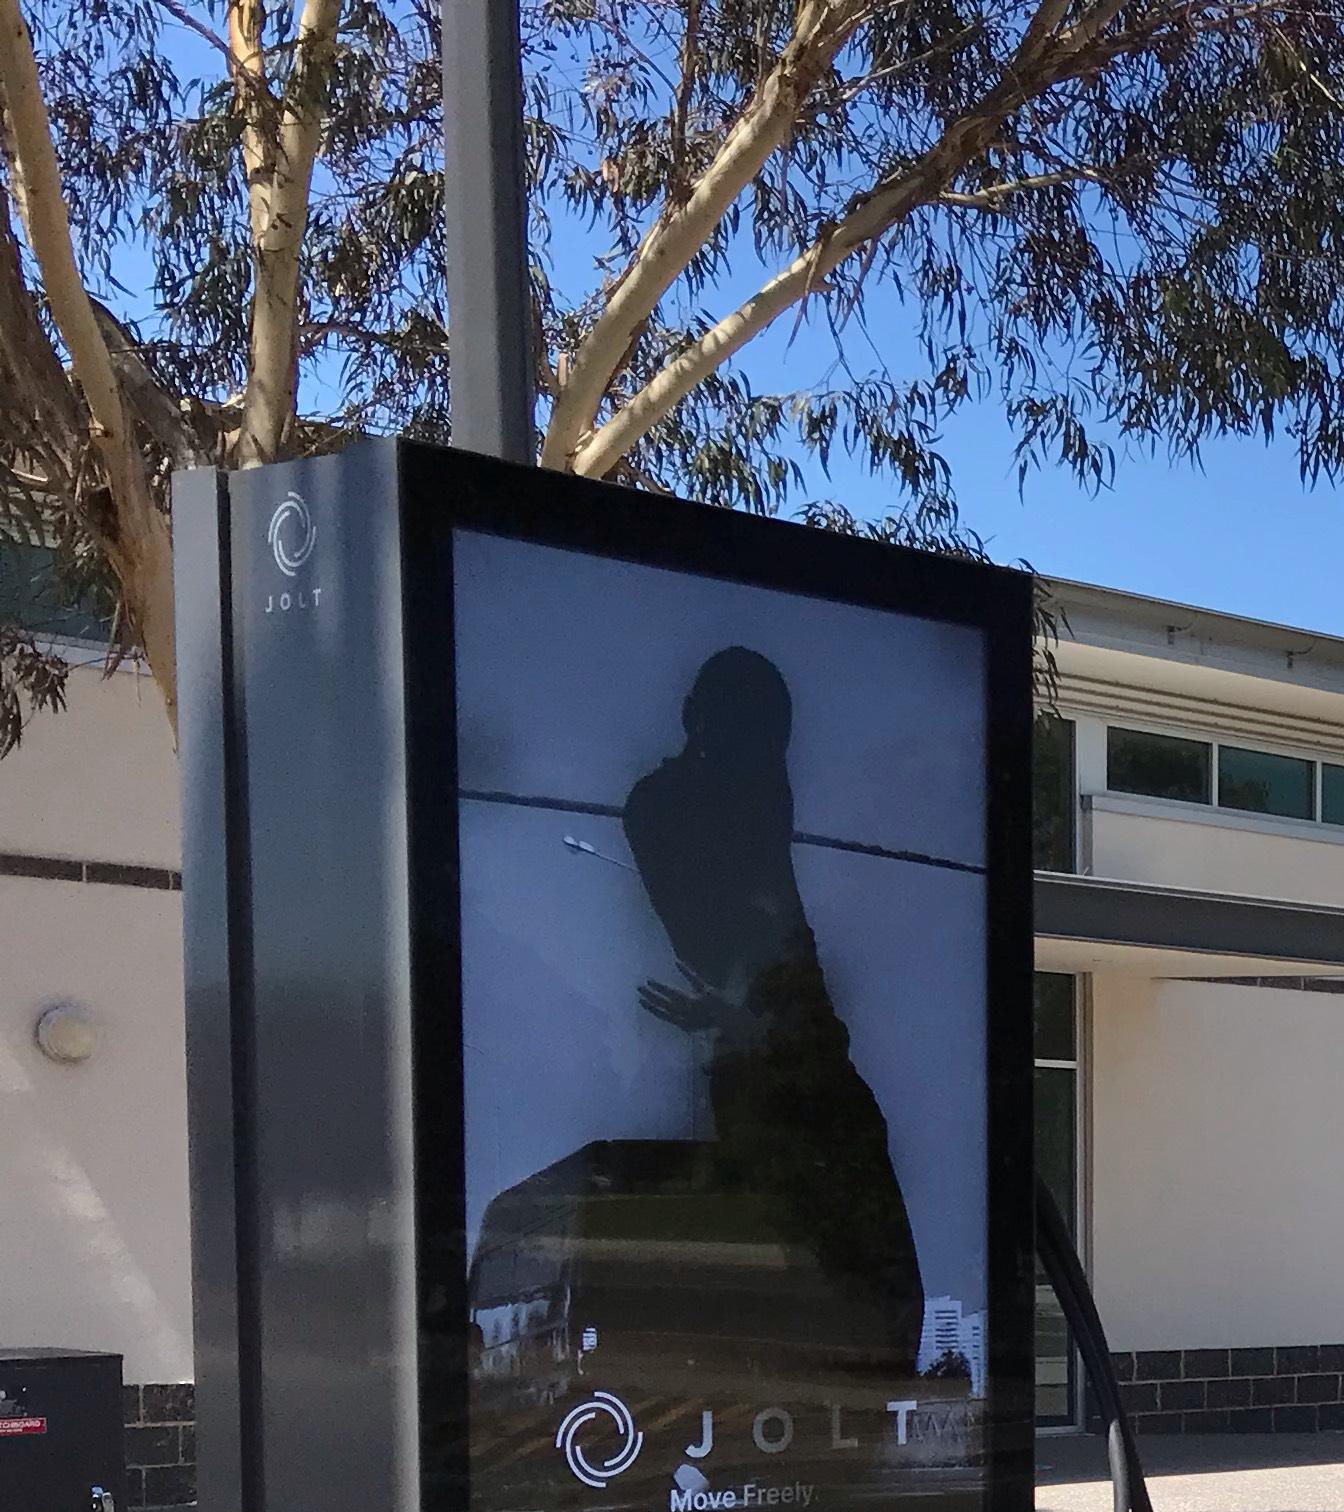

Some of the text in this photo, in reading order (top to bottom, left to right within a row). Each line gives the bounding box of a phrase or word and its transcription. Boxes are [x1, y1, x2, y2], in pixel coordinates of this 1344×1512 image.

[265, 588, 322, 613] JOLT
[684, 1400, 918, 1459] JOLT
[670, 1487, 736, 1512] Move
